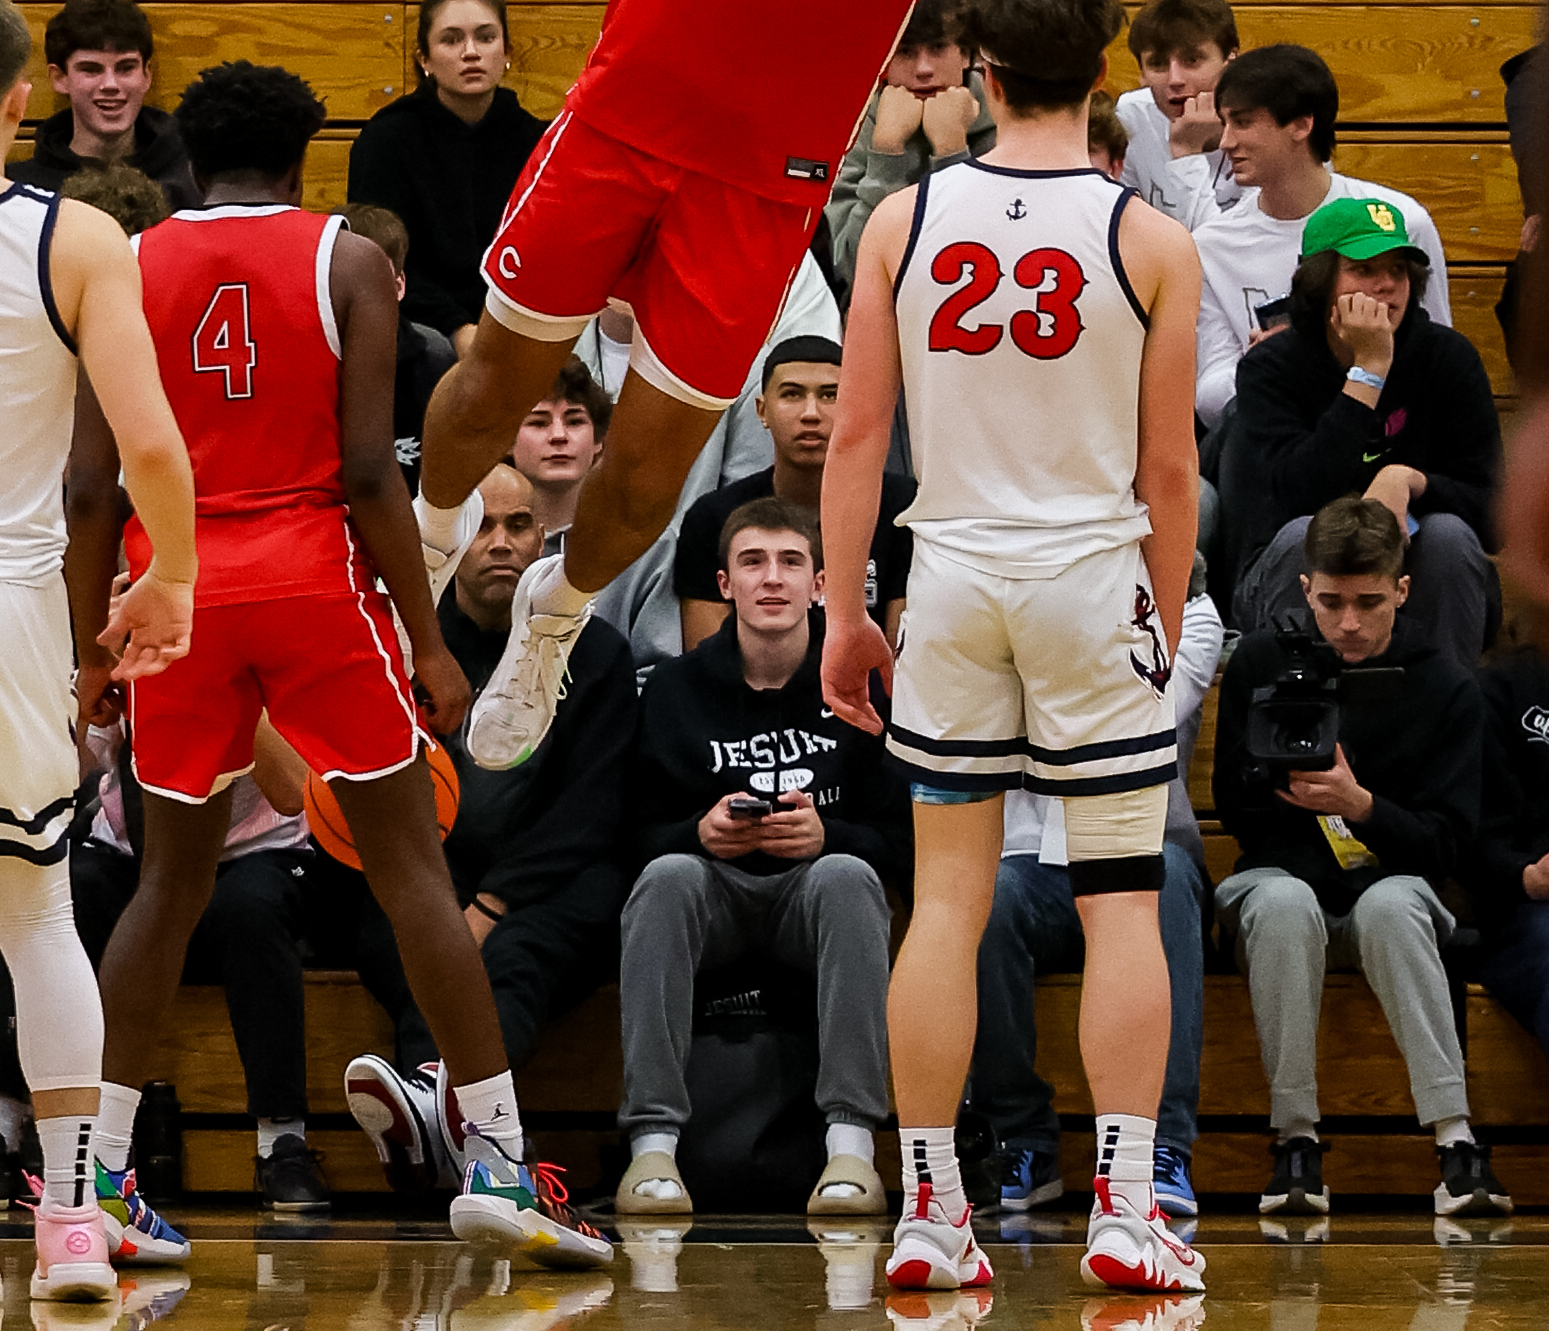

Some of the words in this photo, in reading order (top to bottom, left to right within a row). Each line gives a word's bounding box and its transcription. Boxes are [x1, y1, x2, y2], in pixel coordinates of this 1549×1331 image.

[498, 245, 522, 279] C
[928, 241, 1090, 360] 23
[192, 281, 257, 399] 4
[707, 728, 838, 774] JESUIT
